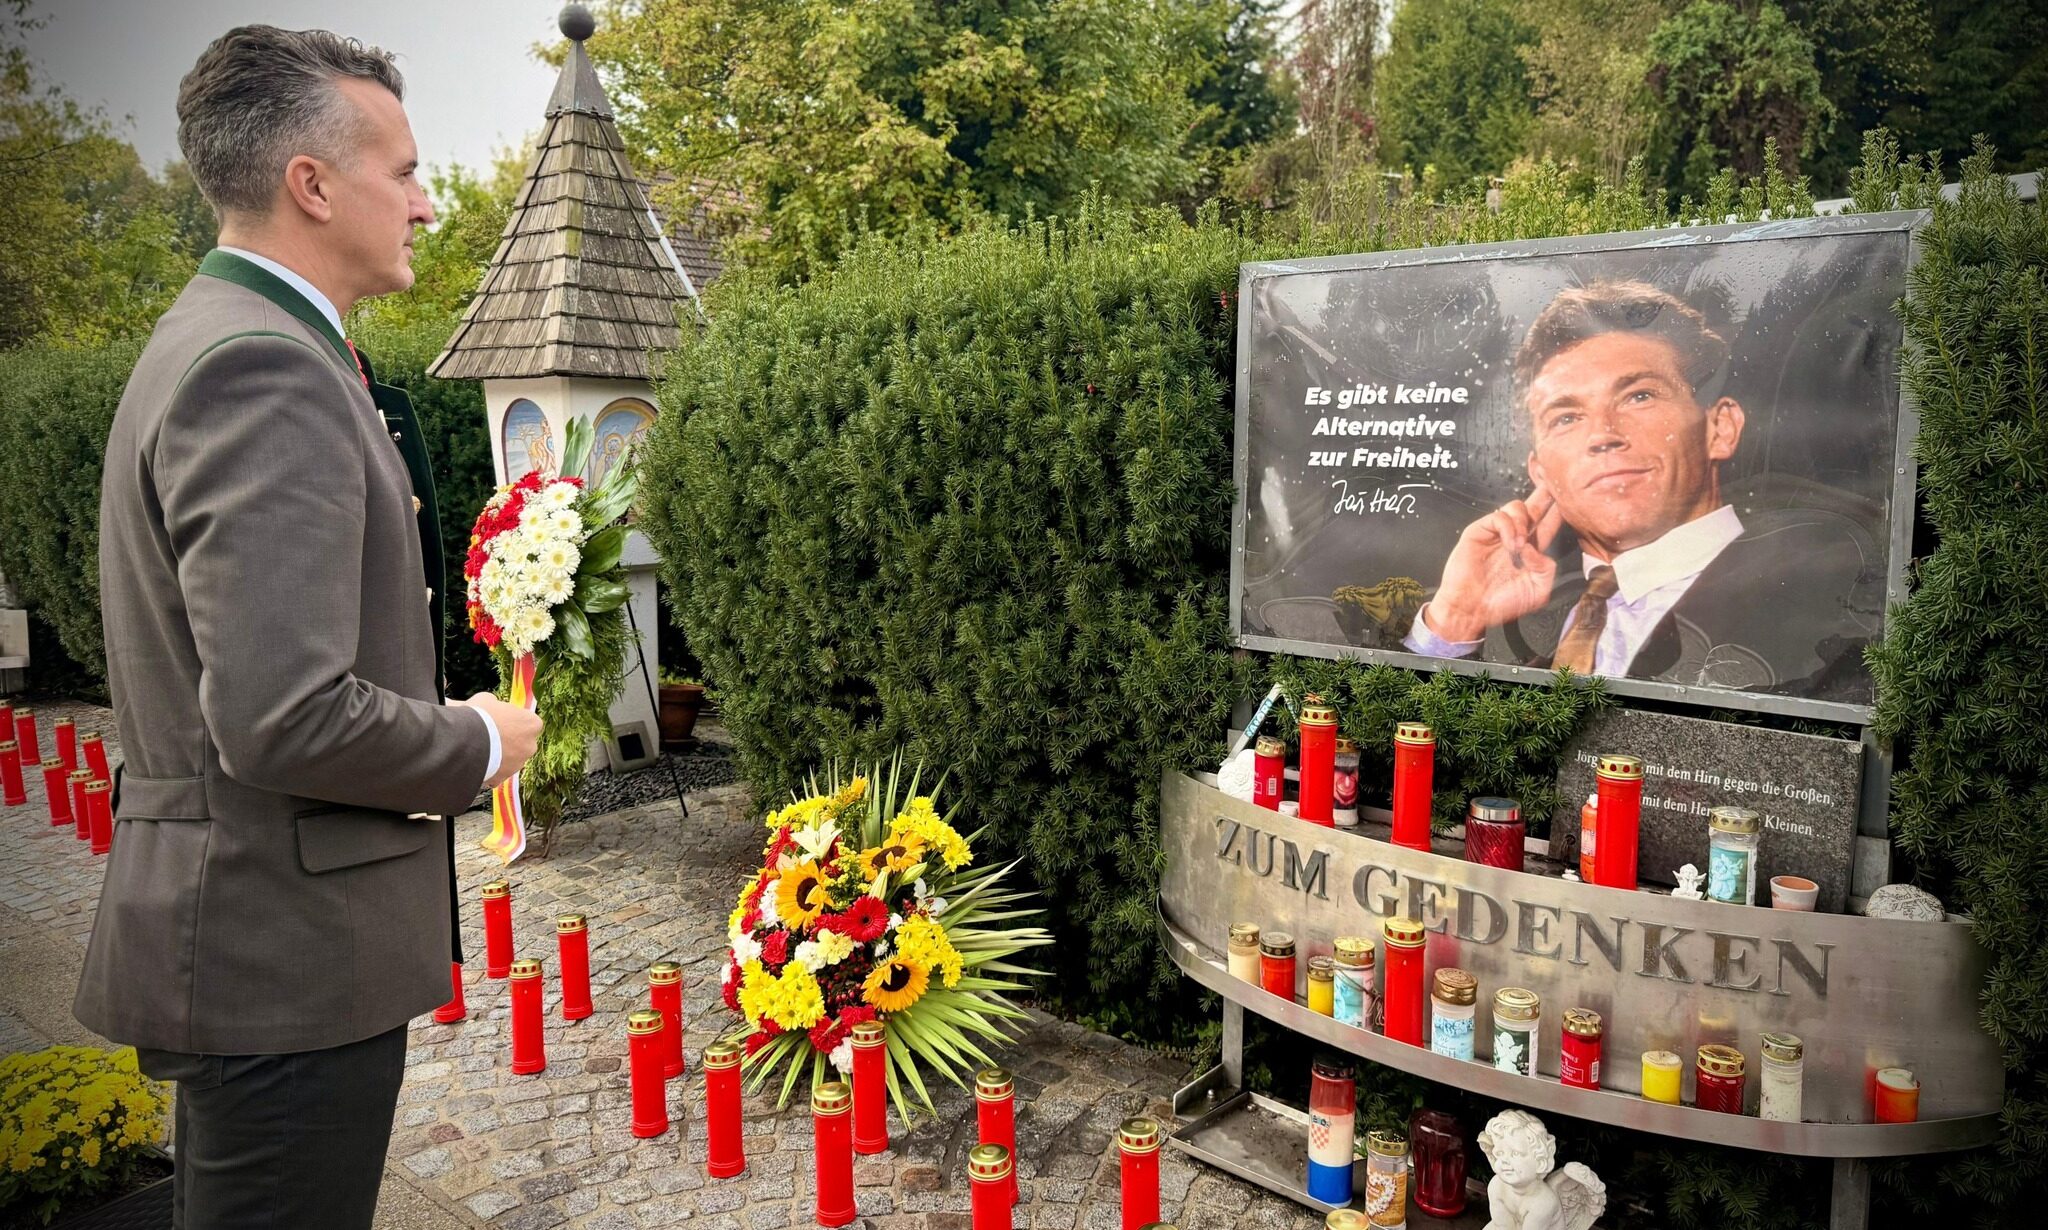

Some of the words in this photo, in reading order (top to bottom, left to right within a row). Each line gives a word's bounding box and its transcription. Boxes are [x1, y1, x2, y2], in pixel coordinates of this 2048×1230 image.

[1305, 387, 1331, 405] Es
[1337, 383, 1388, 409] gibt
[1394, 381, 1468, 404] keine
[1312, 414, 1456, 436] Alternative
[1308, 451, 1347, 467] zur
[1352, 446, 1458, 468] Freiheit.
[1575, 750, 1598, 768] Jörg
[1646, 763, 1664, 776] mit
[1667, 766, 1691, 780] dem
[1695, 769, 1720, 785] Hirn
[1723, 777, 1758, 793] gegen
[1762, 781, 1780, 796] die
[1642, 795, 1660, 807] mit
[1663, 797, 1687, 812] dem
[1690, 801, 1711, 817] Her
[1764, 815, 1812, 835] Kleinen
[1215, 816, 1330, 901] ZUM
[1352, 864, 1836, 997] GEDENKEN
